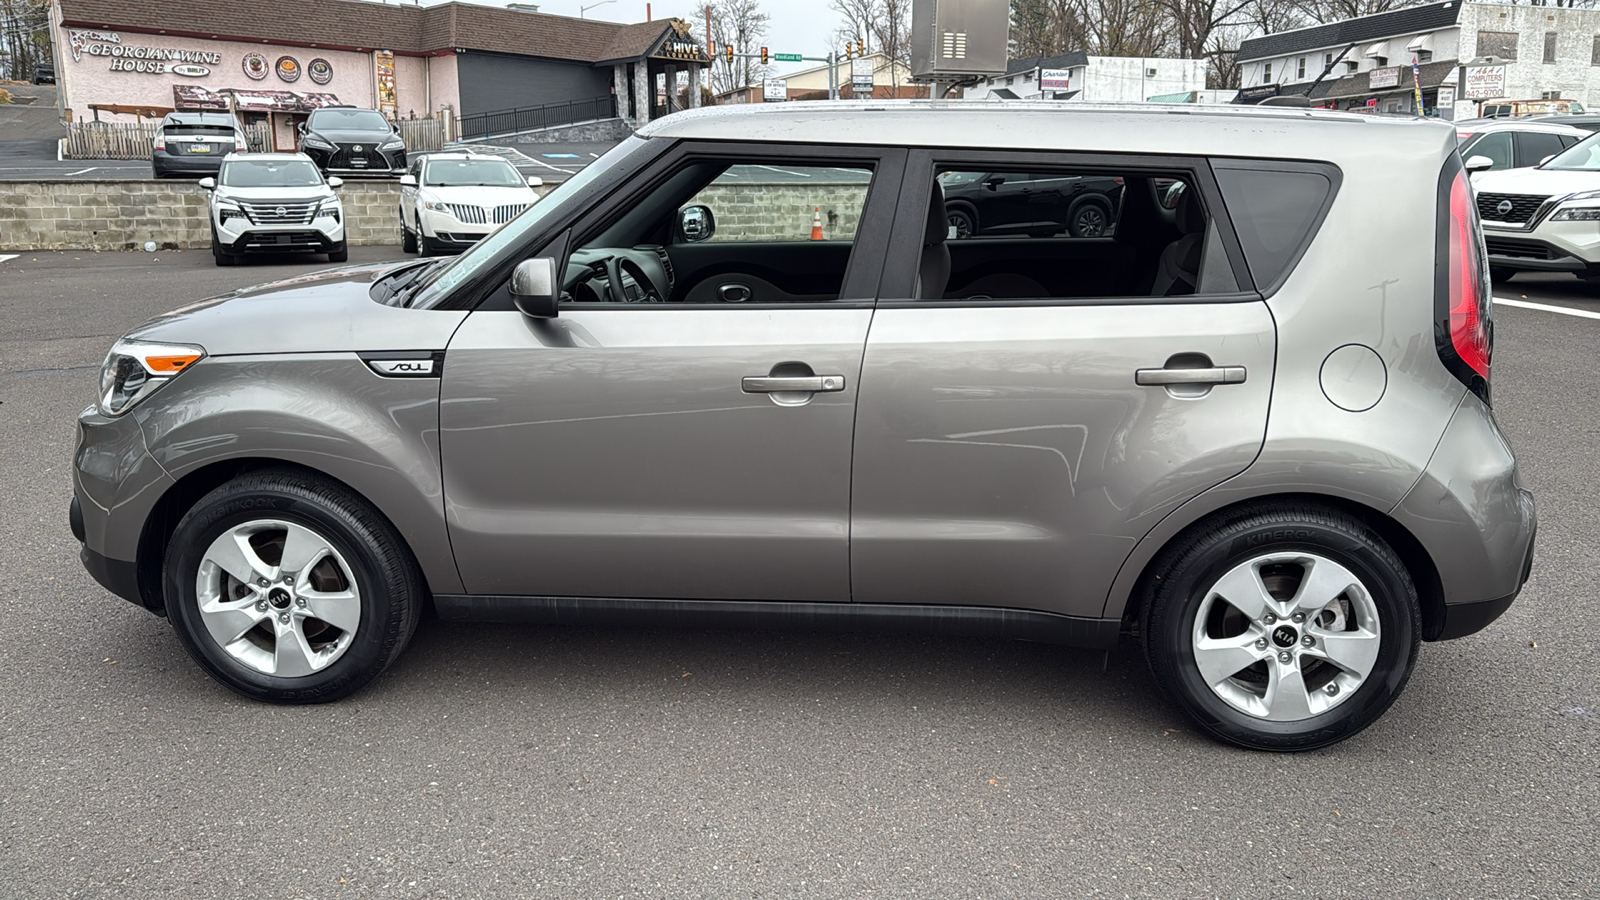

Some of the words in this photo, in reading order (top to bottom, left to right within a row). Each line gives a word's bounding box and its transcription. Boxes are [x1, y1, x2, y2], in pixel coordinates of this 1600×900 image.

[89, 43, 174, 61] GEORGIAN
[178, 49, 221, 64] WINE
[673, 42, 699, 55] HIVE
[666, 52, 699, 60] LOUNGE
[110, 58, 166, 74] HOUSE
[1467, 74, 1503, 83] COMPUTERS
[1465, 89, 1503, 98] 942-9700
[389, 363, 429, 371] SOUL
[270, 592, 289, 605] KIA
[1275, 629, 1294, 644] KIA
